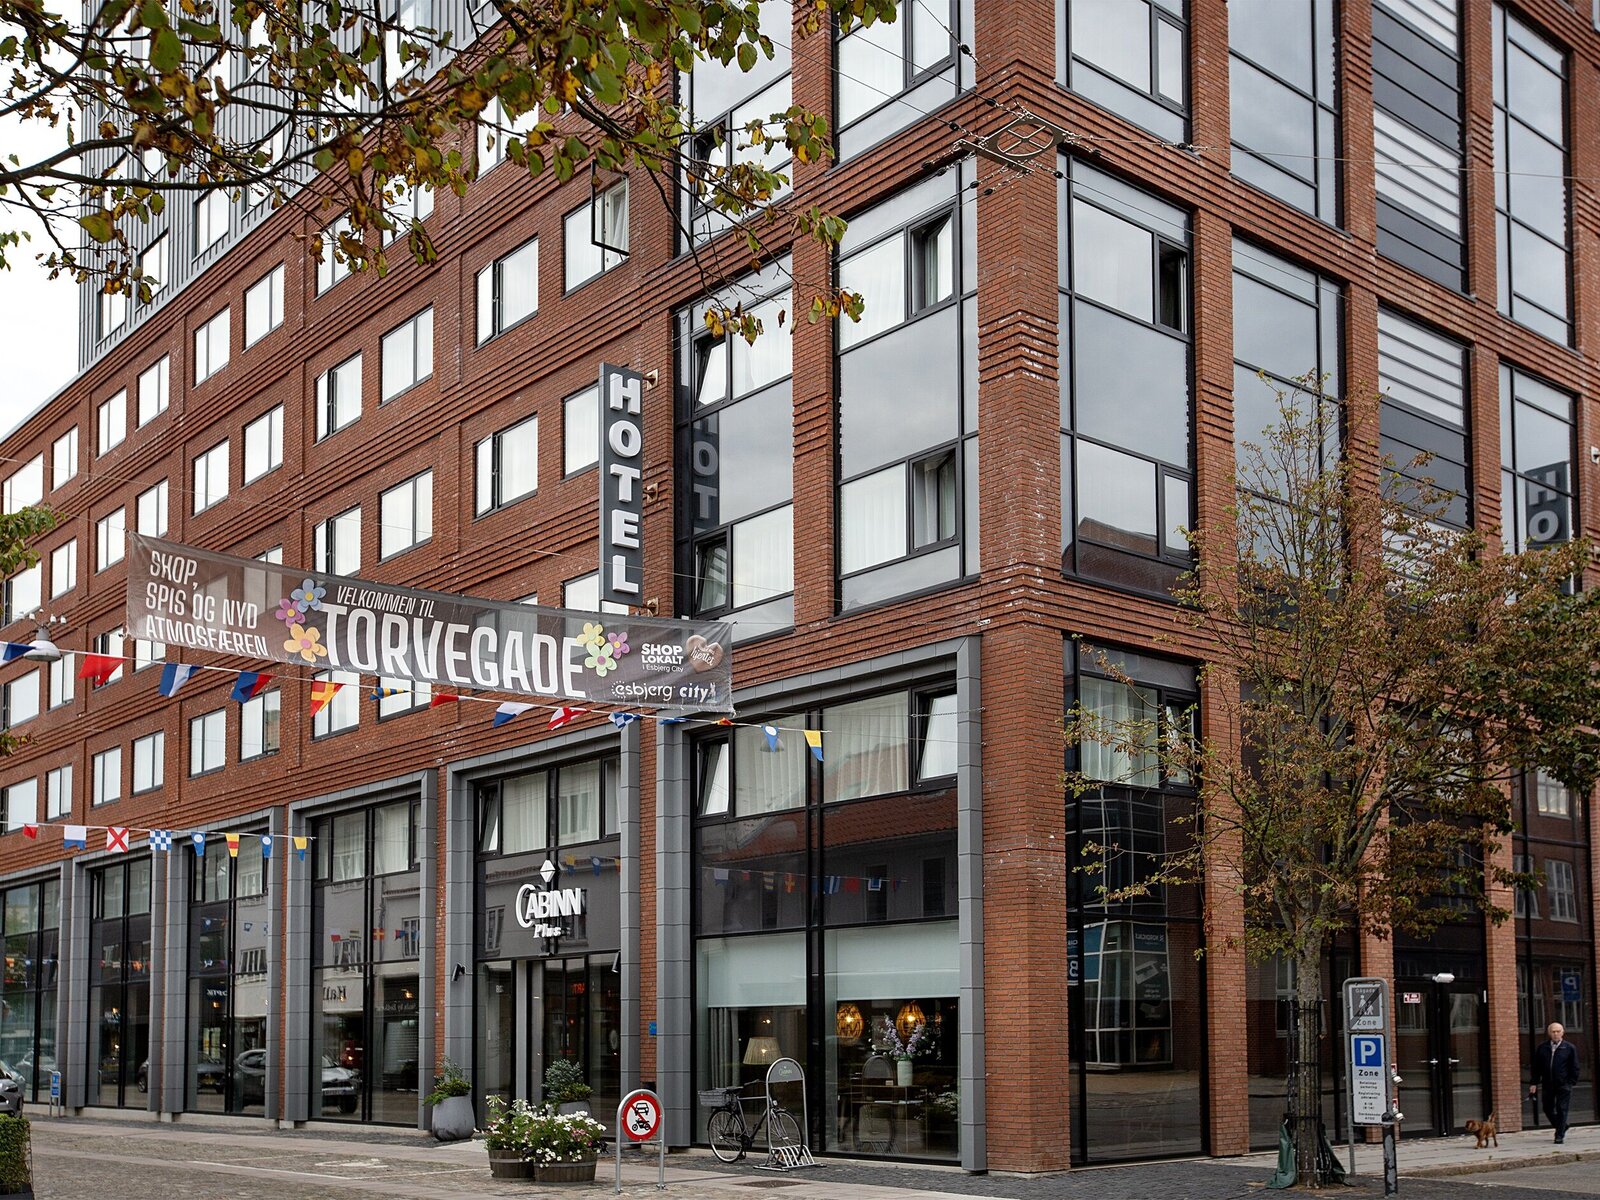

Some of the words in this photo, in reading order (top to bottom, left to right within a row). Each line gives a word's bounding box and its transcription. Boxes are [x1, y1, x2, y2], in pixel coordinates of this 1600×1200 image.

[608, 372, 642, 594] HOTEL
[150, 550, 198, 590] SHOP,
[145, 583, 185, 616] SPIS
[192, 592, 215, 623] OG
[222, 599, 258, 629] NYD
[336, 585, 417, 615] VELKOMMEN
[417, 599, 435, 618] TIL
[145, 614, 269, 656] ATMOSFÆREN
[641, 643, 683, 655] SHOP
[318, 602, 587, 698] TORVEGADE
[641, 655, 684, 665] LOKALT
[646, 664, 671, 673] Esbjerg
[613, 681, 673, 702] esbjerg
[679, 683, 709, 703] city
[515, 883, 581, 928] CABINN
[533, 923, 561, 938] Plus
[1360, 1040, 1376, 1065] P
[1358, 1069, 1379, 1077] Zone
